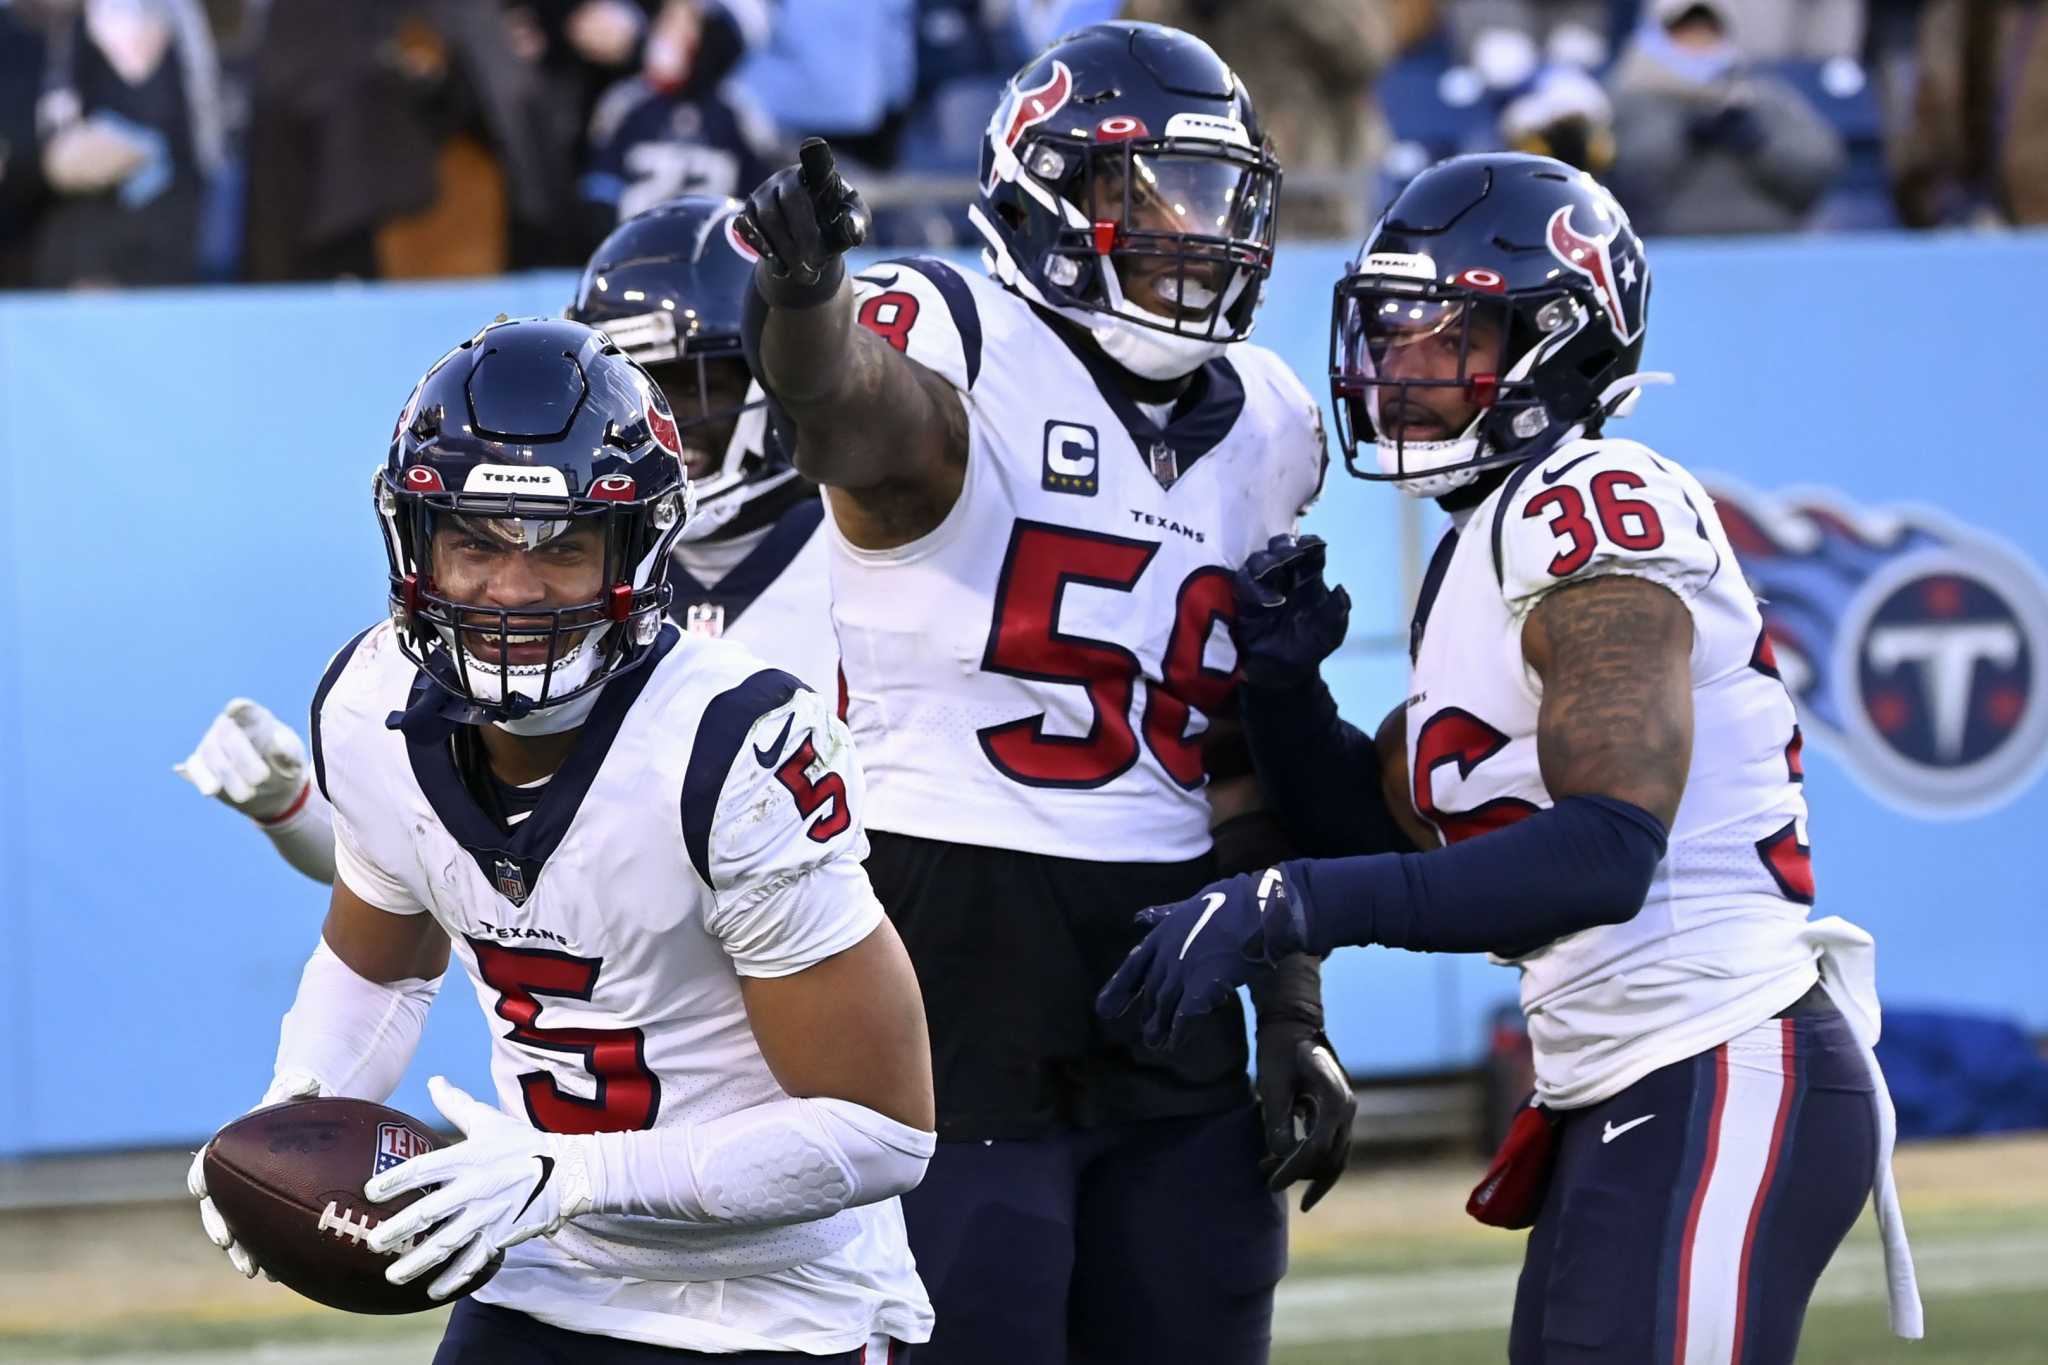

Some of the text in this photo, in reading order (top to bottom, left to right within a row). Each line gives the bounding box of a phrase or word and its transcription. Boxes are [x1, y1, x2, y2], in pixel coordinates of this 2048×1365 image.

[482, 472, 552, 484] TEXANS
[1047, 424, 1095, 477] C
[1128, 509, 1206, 544] TEXANS
[1522, 469, 1665, 577] 36
[1869, 624, 2019, 757] T
[773, 730, 851, 843] 5
[478, 919, 568, 946] TEXANS
[462, 931, 661, 1136] 5
